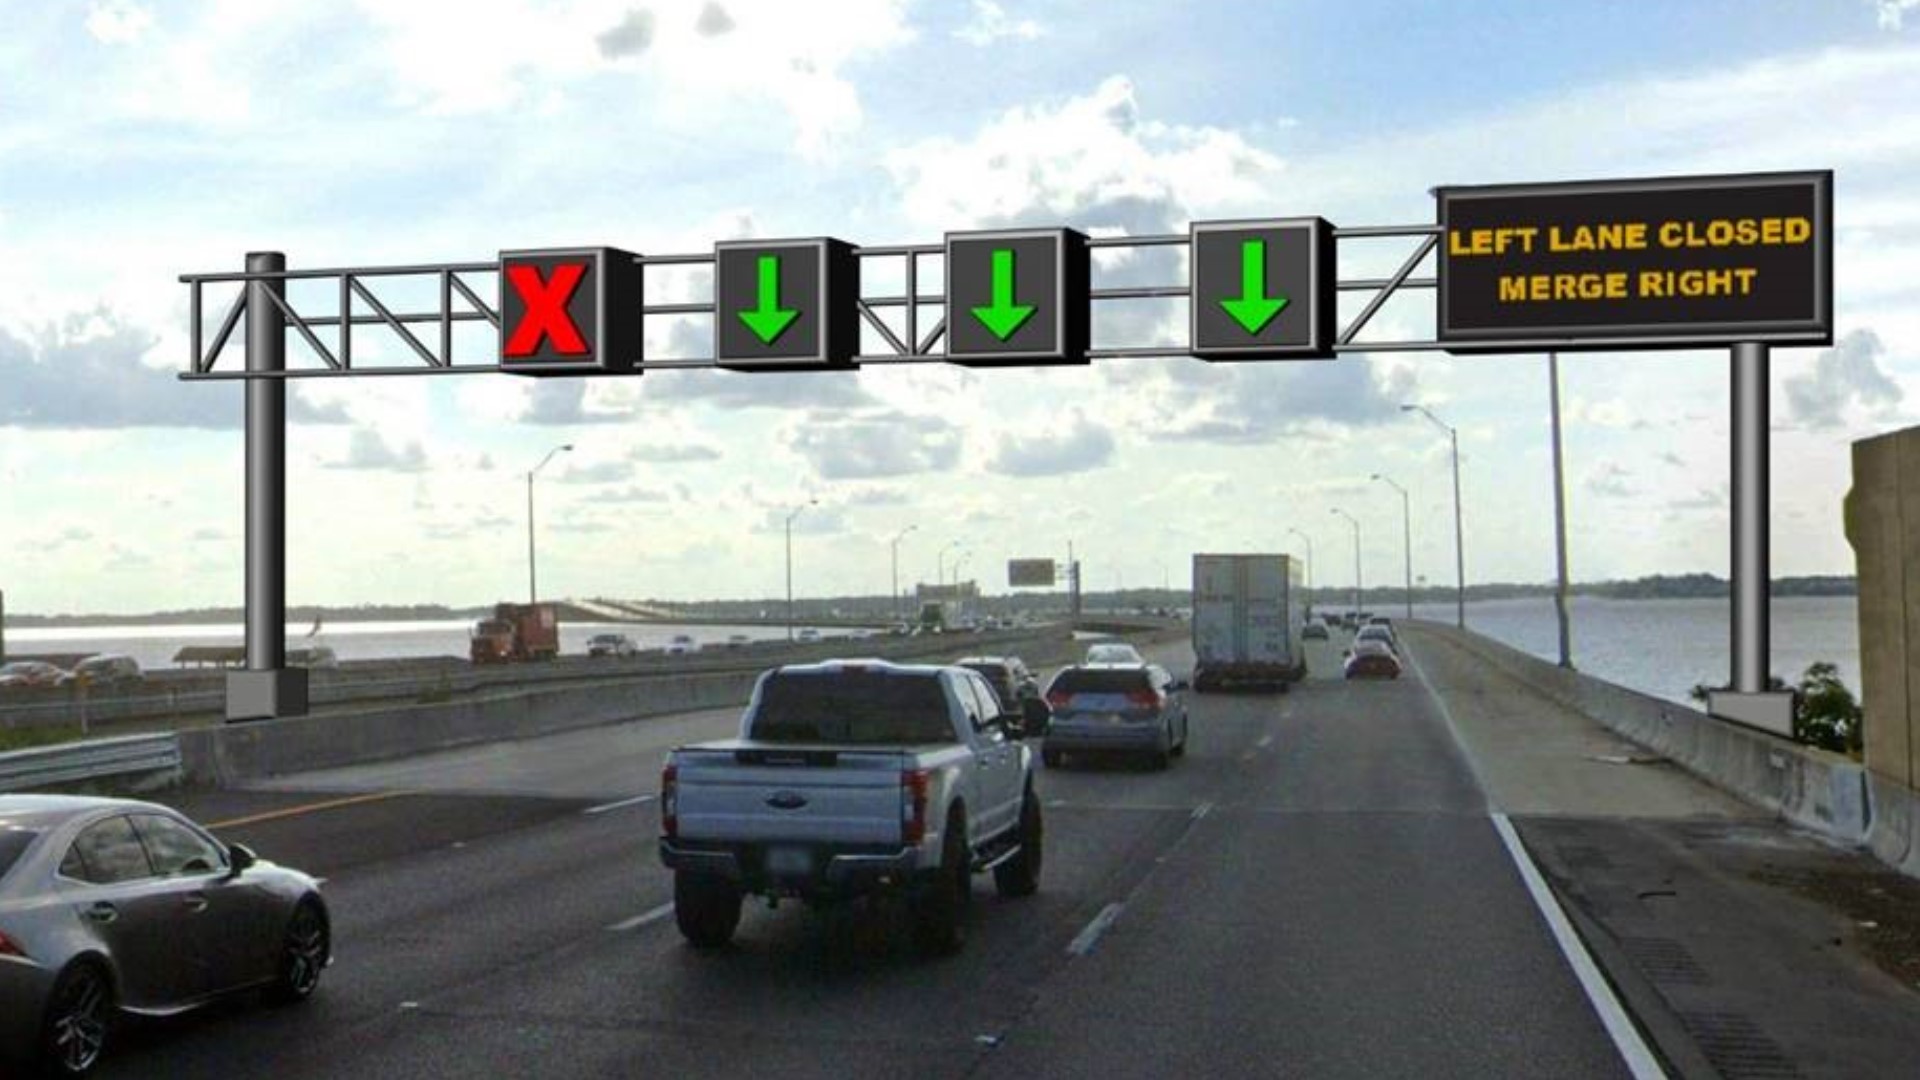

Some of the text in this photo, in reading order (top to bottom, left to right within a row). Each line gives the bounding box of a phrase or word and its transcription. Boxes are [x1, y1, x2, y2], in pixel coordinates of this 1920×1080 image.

[1449, 217, 1811, 256] LEFT LANE CLOSED
[1498, 268, 1758, 301] MERGE RIGHT
